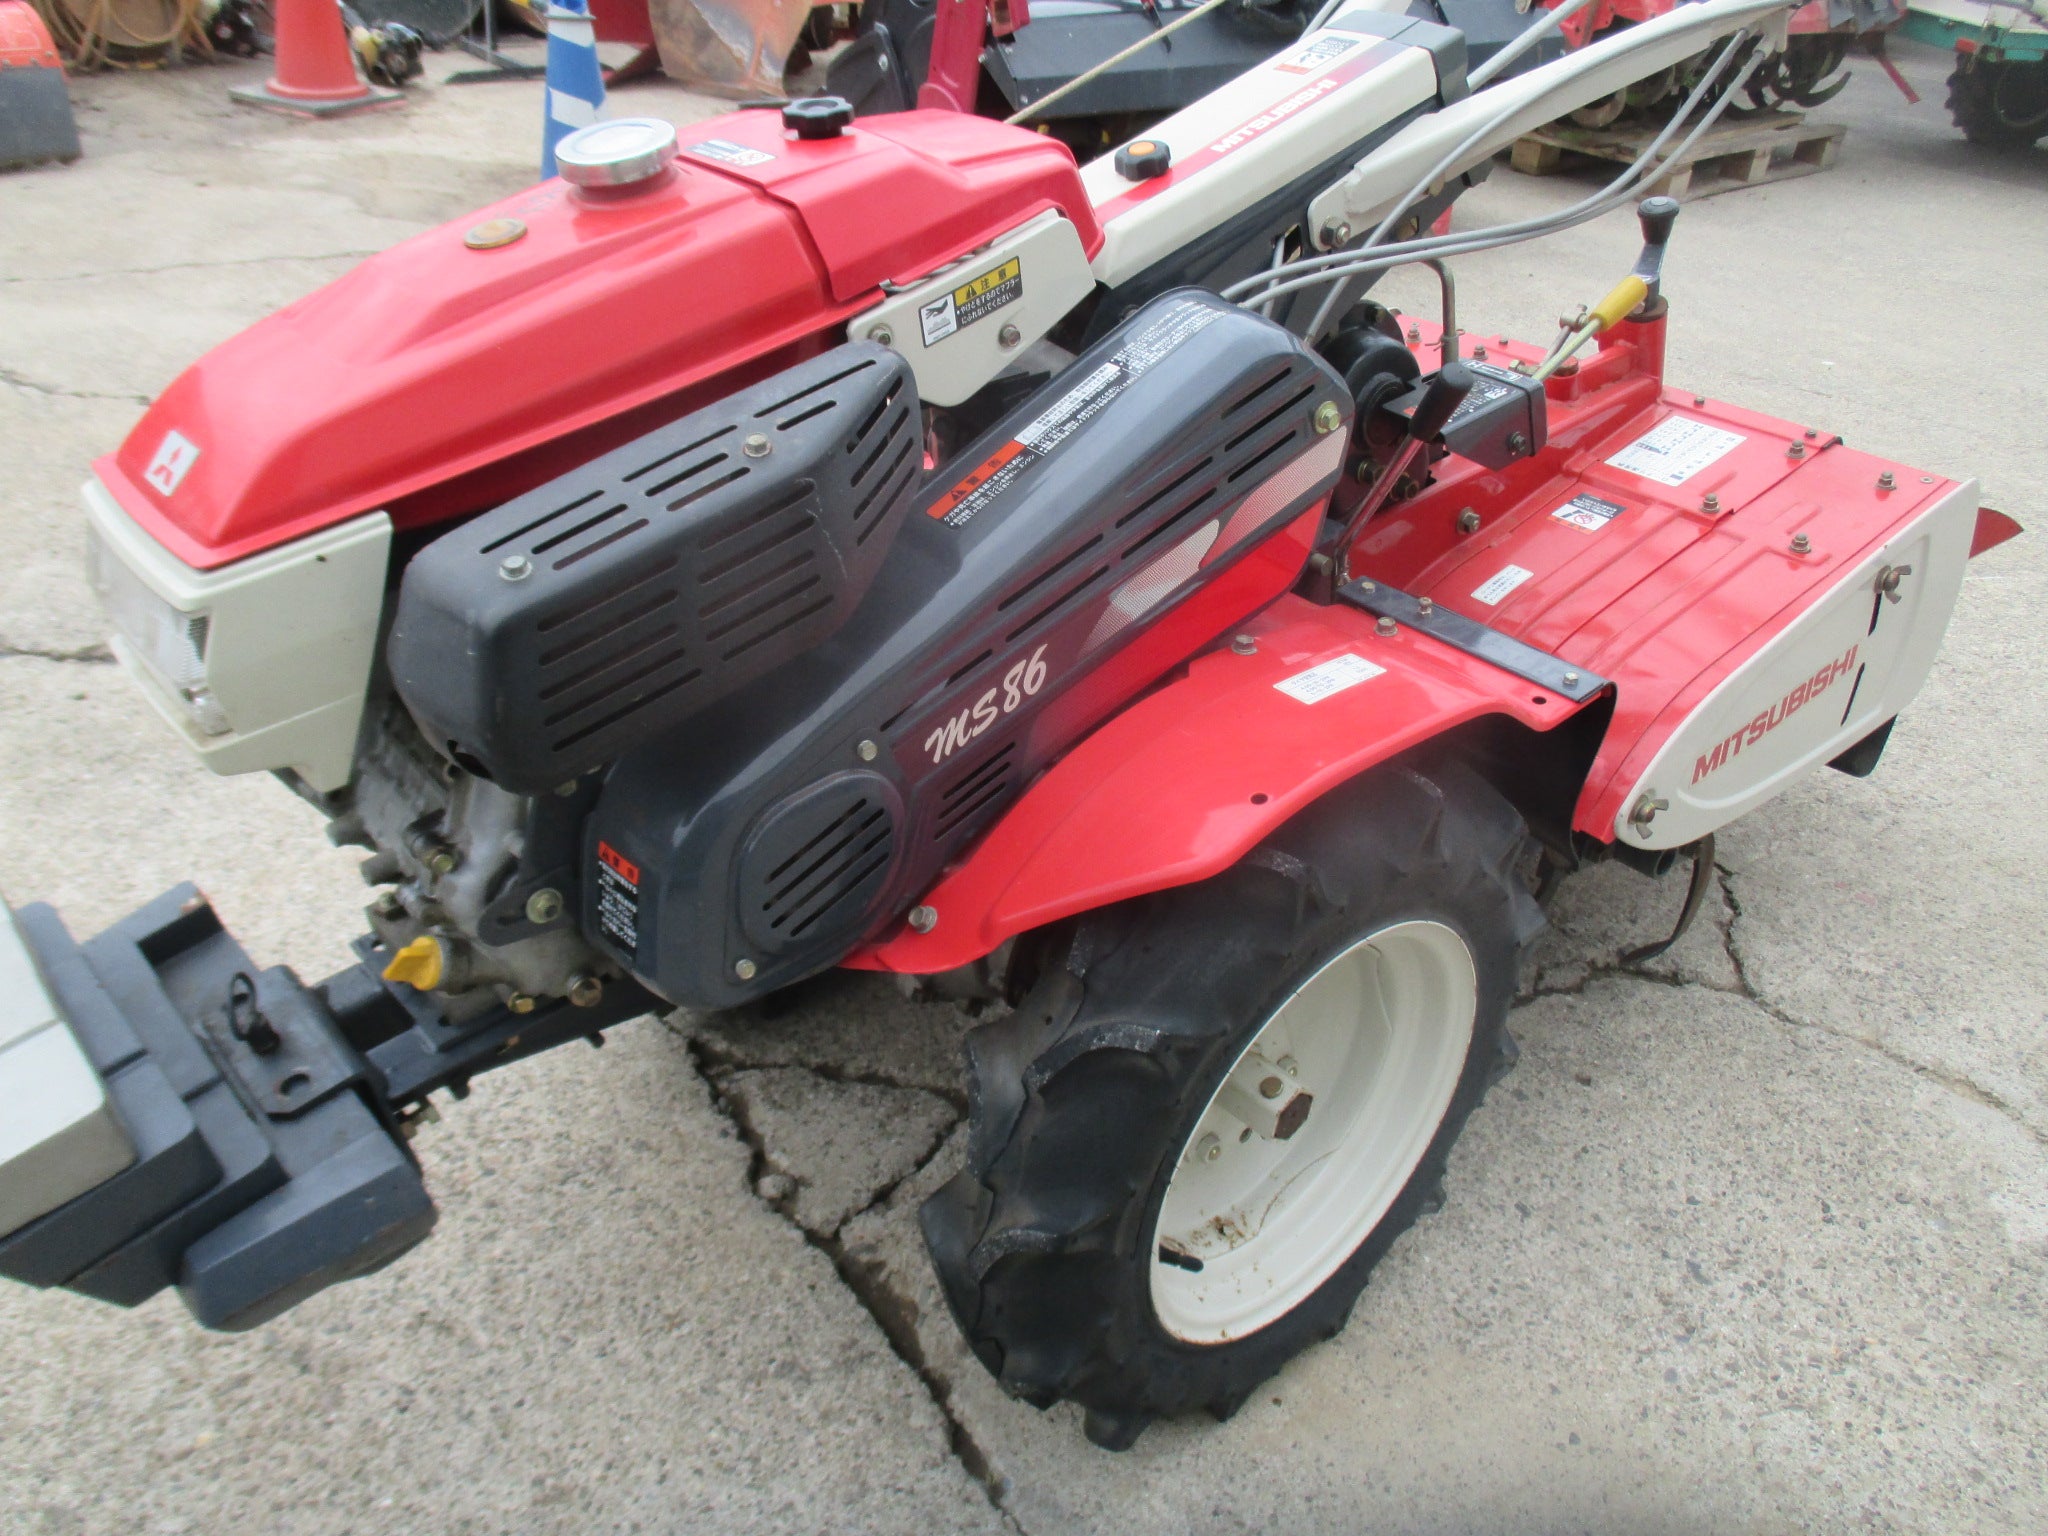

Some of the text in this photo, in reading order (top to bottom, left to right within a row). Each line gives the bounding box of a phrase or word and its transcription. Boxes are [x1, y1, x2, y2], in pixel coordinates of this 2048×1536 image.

[1210, 79, 1338, 152] MITSUBISHI
[925, 643, 1048, 764] MS86
[1691, 644, 1858, 785] MITSUBISHI
